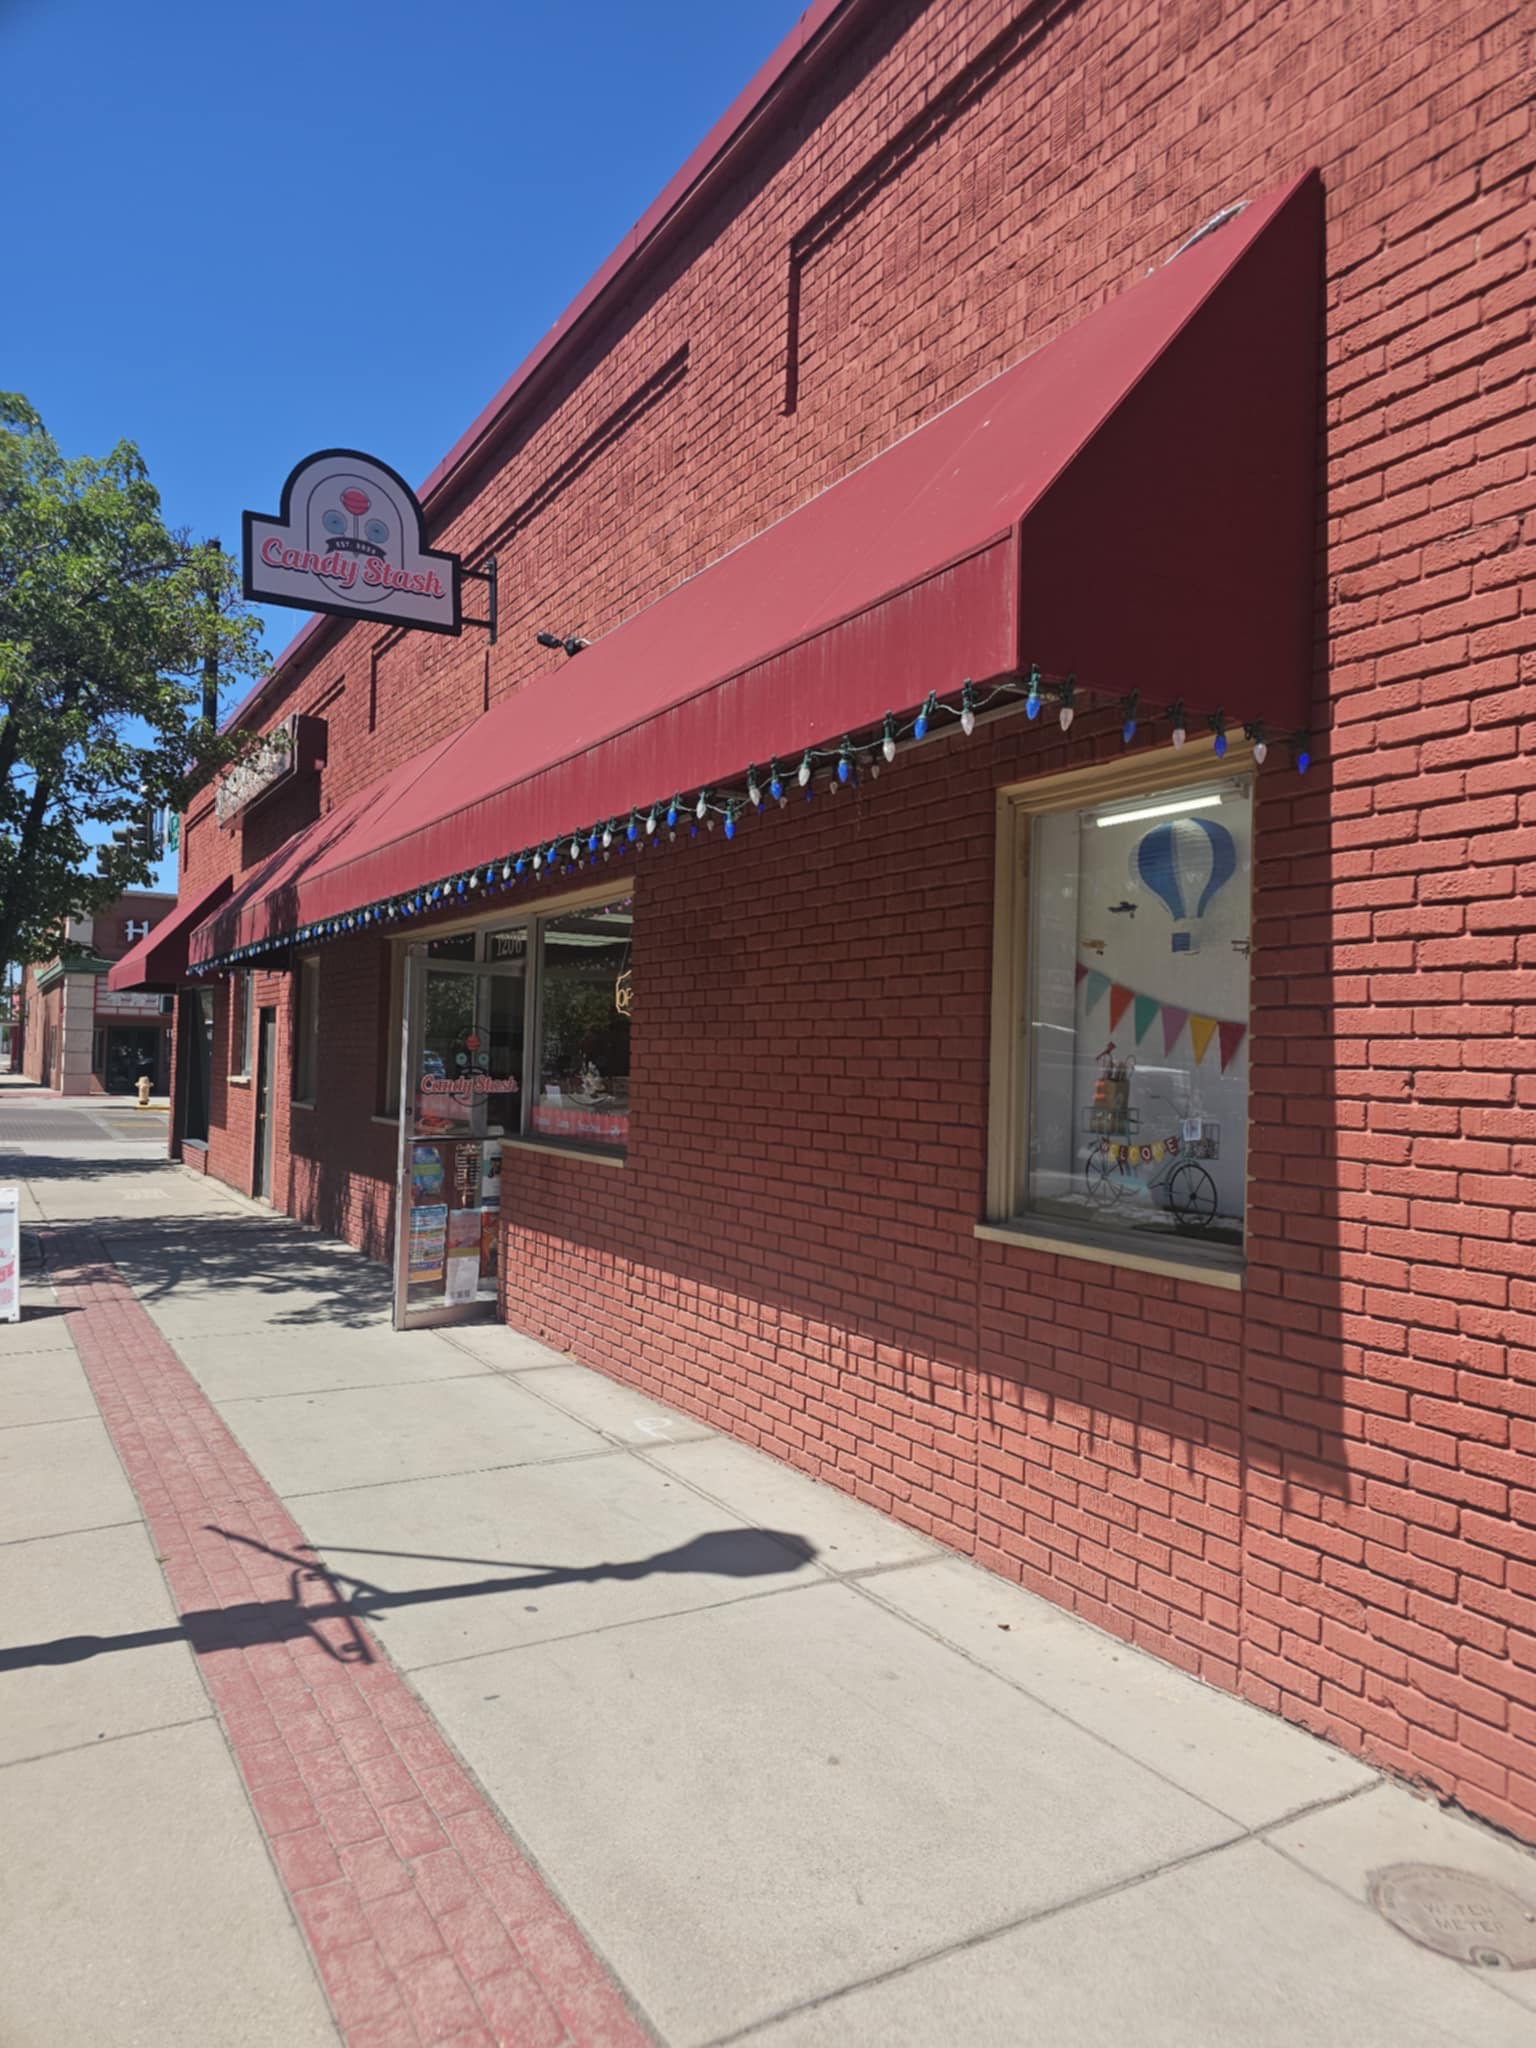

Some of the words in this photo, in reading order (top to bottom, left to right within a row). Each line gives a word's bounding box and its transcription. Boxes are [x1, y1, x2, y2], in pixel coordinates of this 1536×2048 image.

[261, 537, 358, 589] Candy
[363, 556, 446, 598] Stash
[421, 1074, 473, 1100] Candy
[473, 1074, 519, 1094] Stash
[1101, 1138, 1178, 1160] WELCOME
[1433, 1918, 1505, 1934] METER
